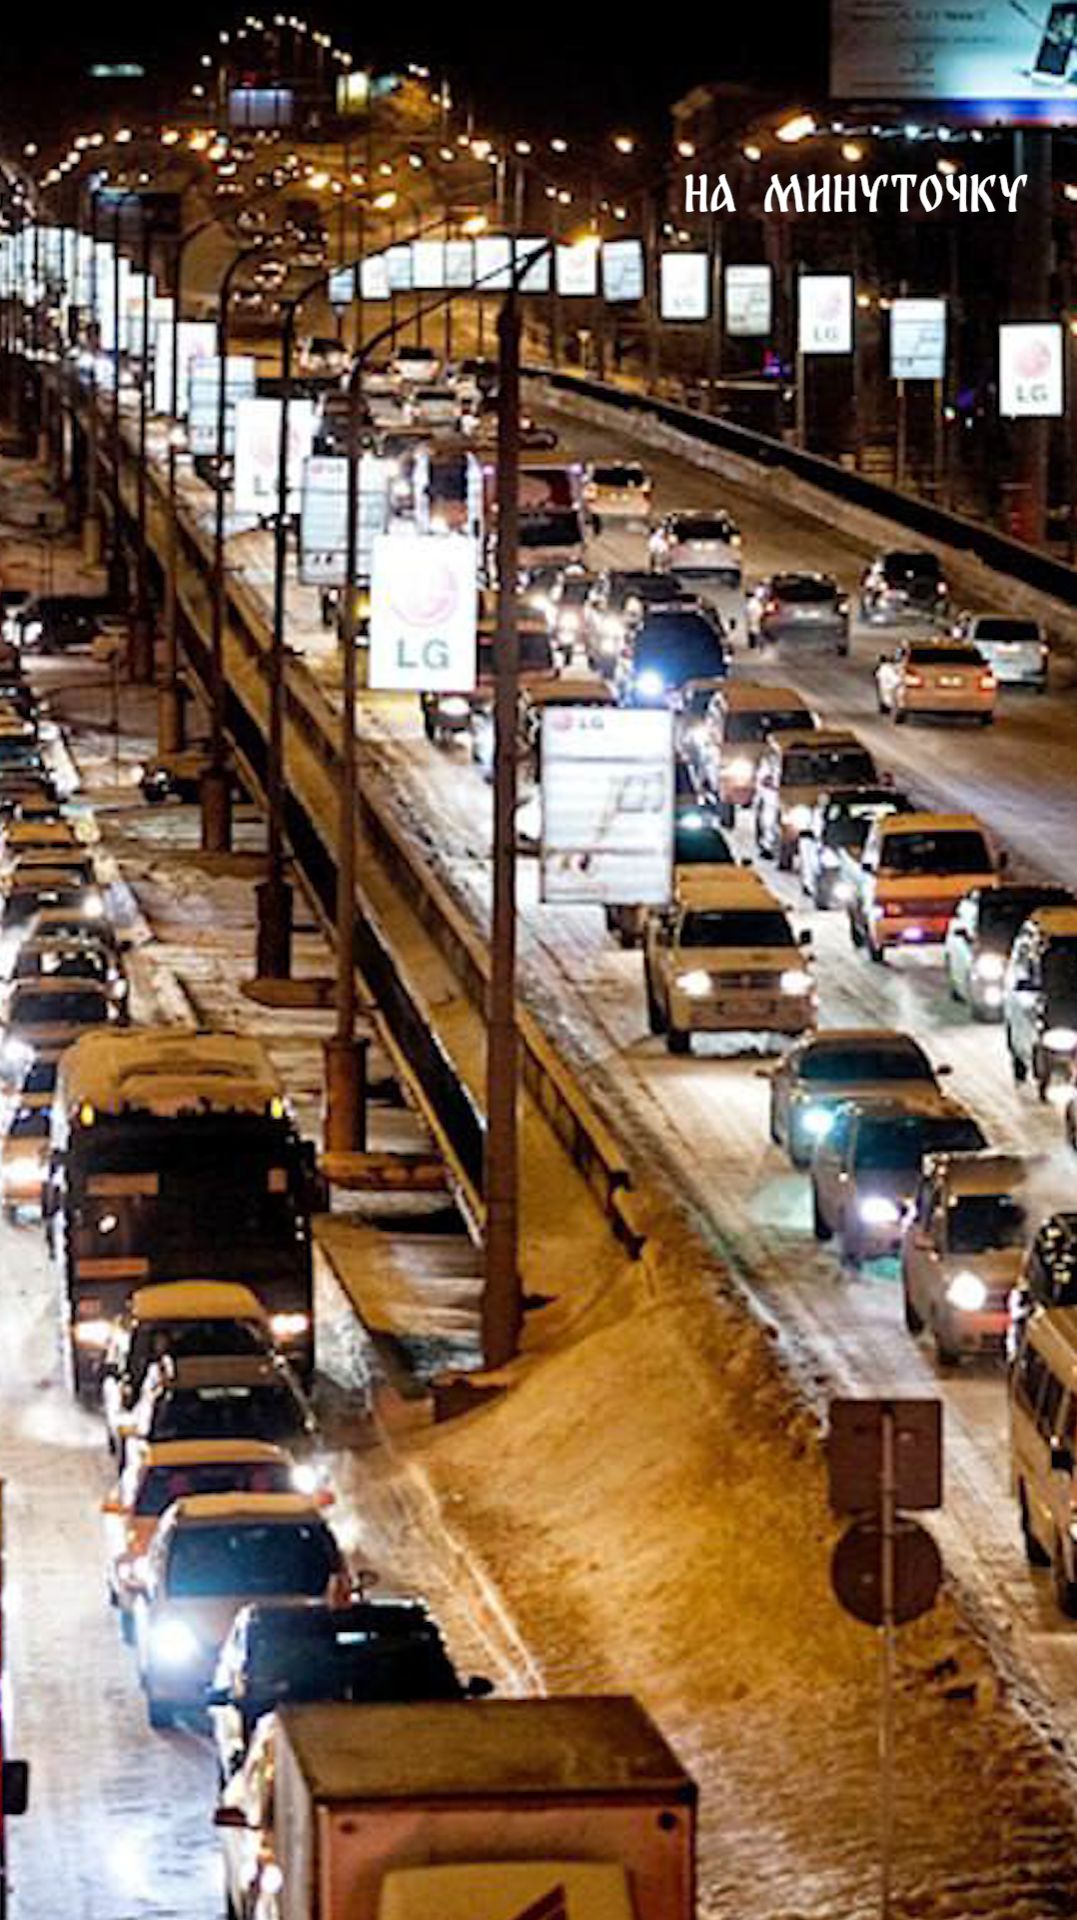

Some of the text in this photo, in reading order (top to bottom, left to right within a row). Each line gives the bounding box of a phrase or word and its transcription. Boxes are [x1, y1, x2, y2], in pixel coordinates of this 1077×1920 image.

[1016, 384, 1048, 403] LG
[396, 637, 450, 669] LG
[578, 715, 605, 731] LG
